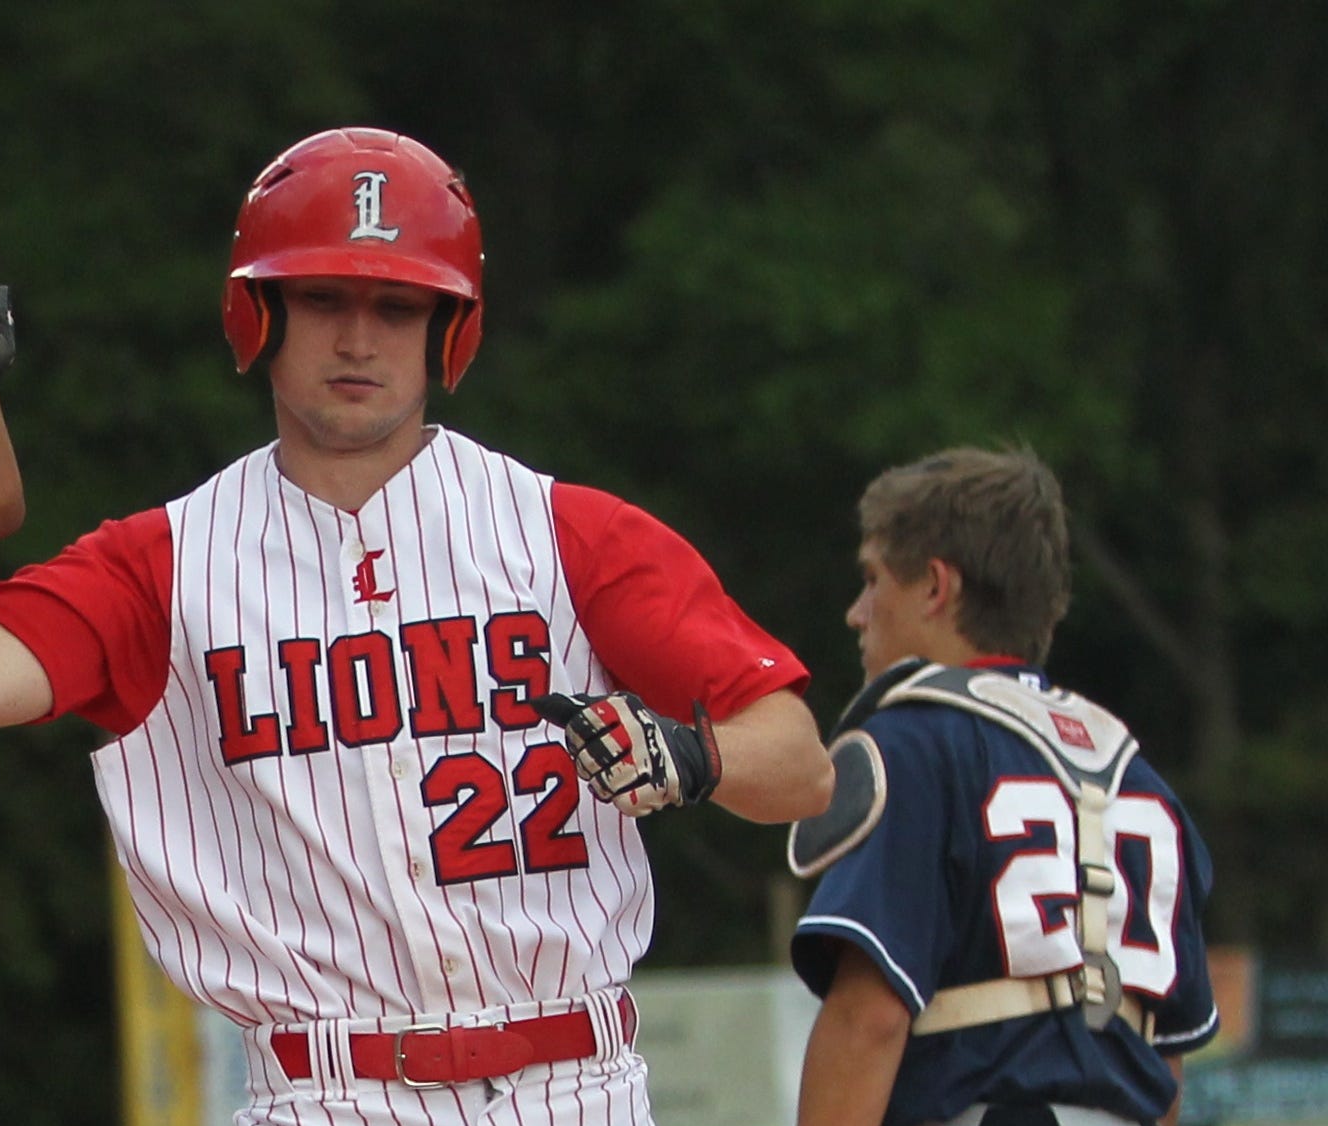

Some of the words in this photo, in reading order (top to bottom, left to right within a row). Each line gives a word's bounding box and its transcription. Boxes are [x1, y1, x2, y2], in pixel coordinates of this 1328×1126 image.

[348, 170, 400, 243] L
[351, 547, 397, 604] L
[204, 610, 551, 767] LIONS
[420, 741, 590, 886] 22
[981, 775, 1182, 999] 20
